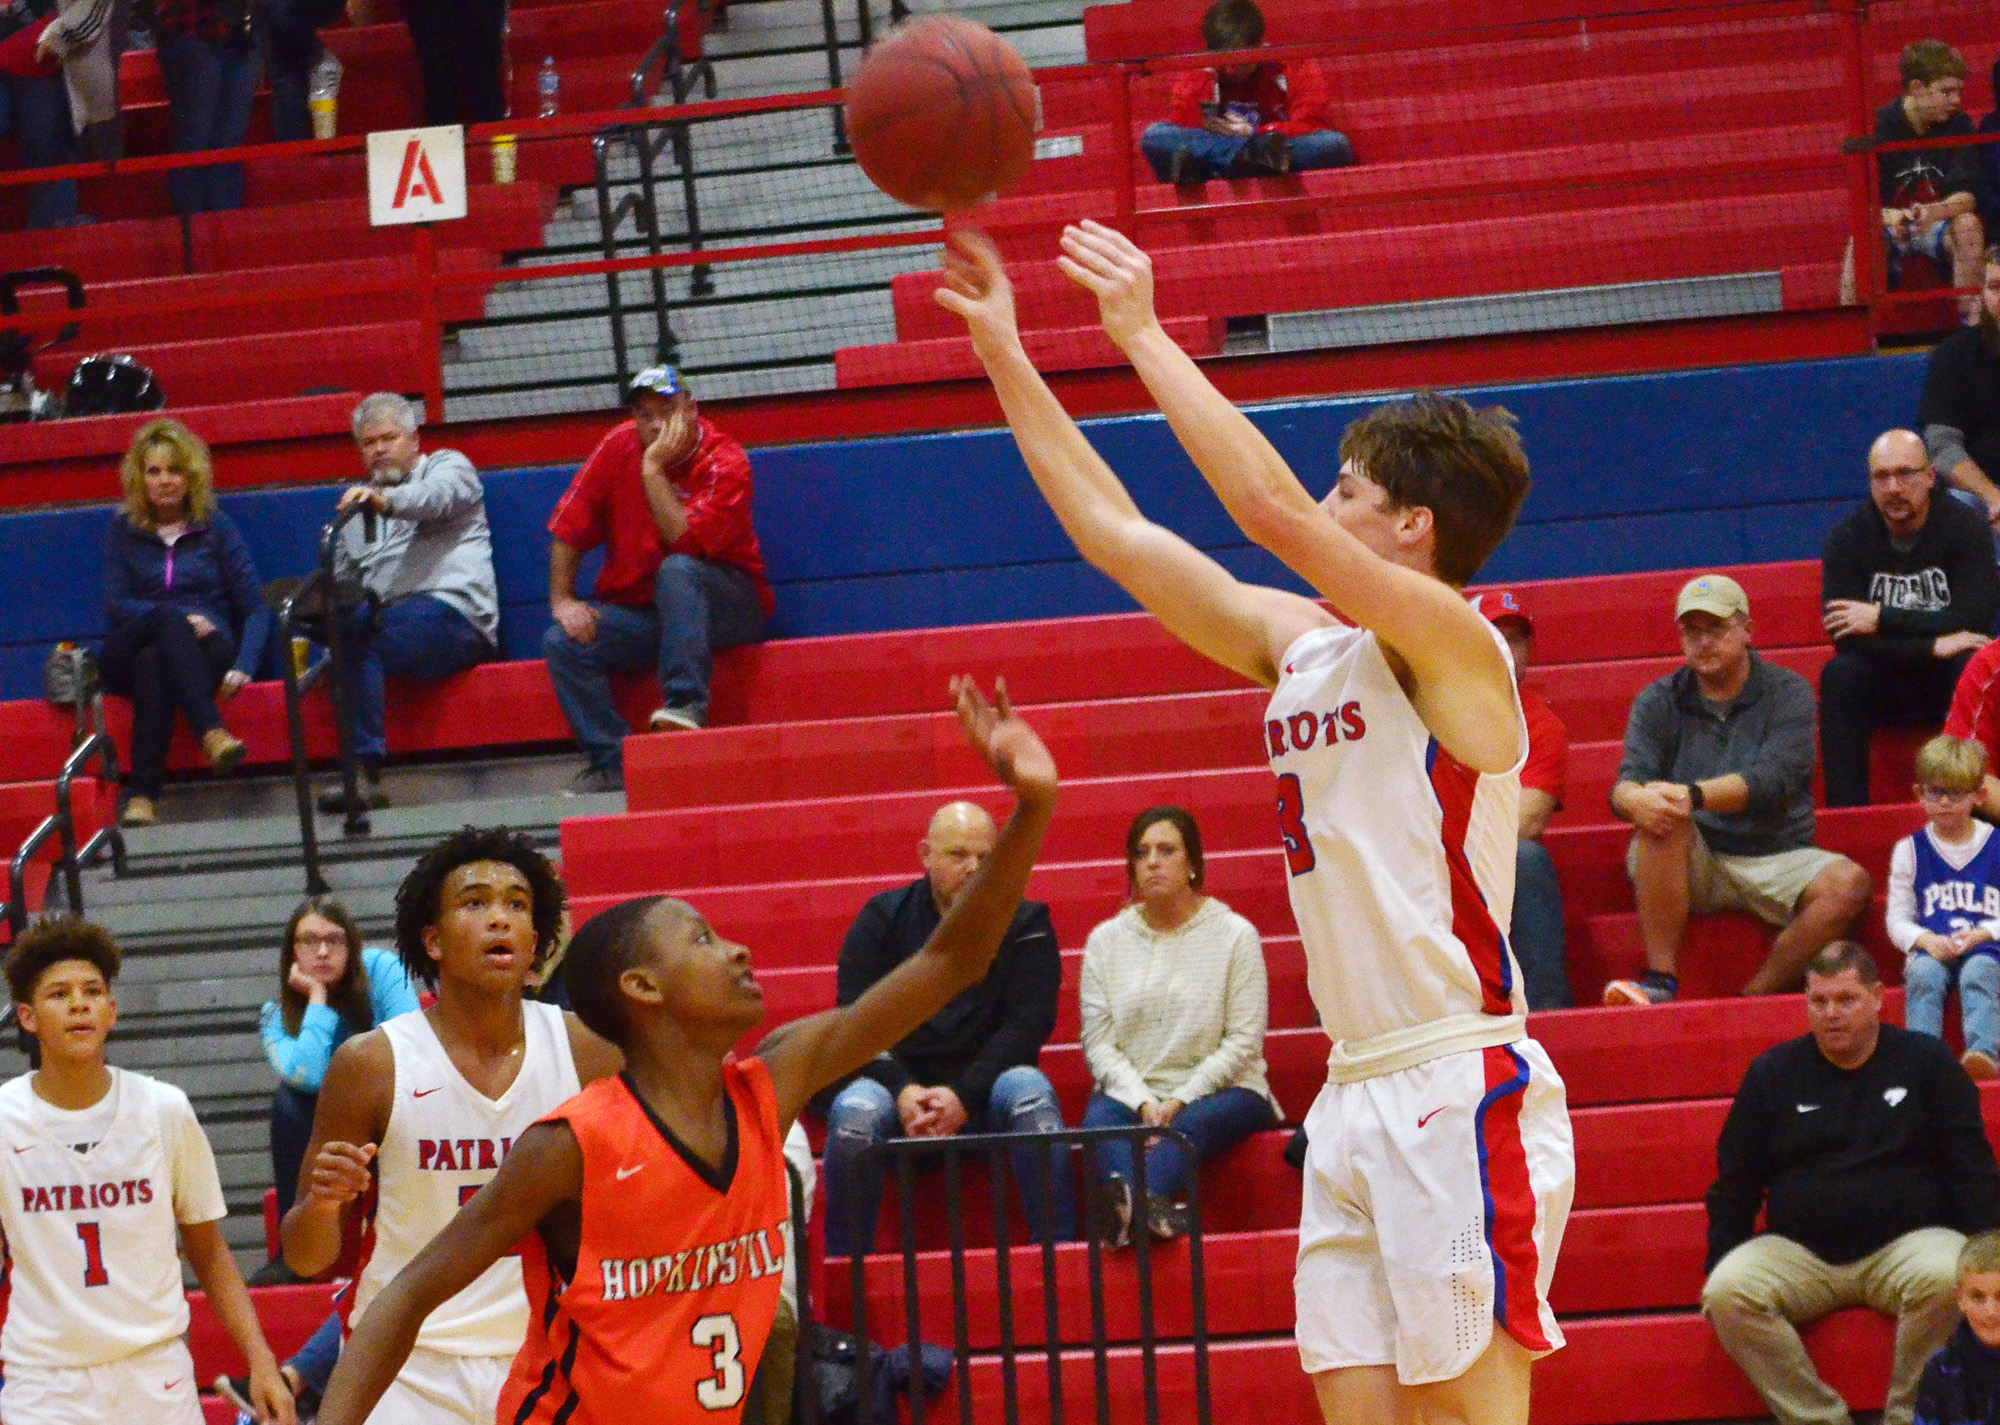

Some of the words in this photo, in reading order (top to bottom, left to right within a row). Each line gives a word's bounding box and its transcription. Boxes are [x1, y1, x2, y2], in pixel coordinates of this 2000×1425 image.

[392, 140, 444, 209] A
[21, 1178, 153, 1213] PATRIOTS
[76, 1222, 109, 1287] 1
[690, 1313, 745, 1412] 3
